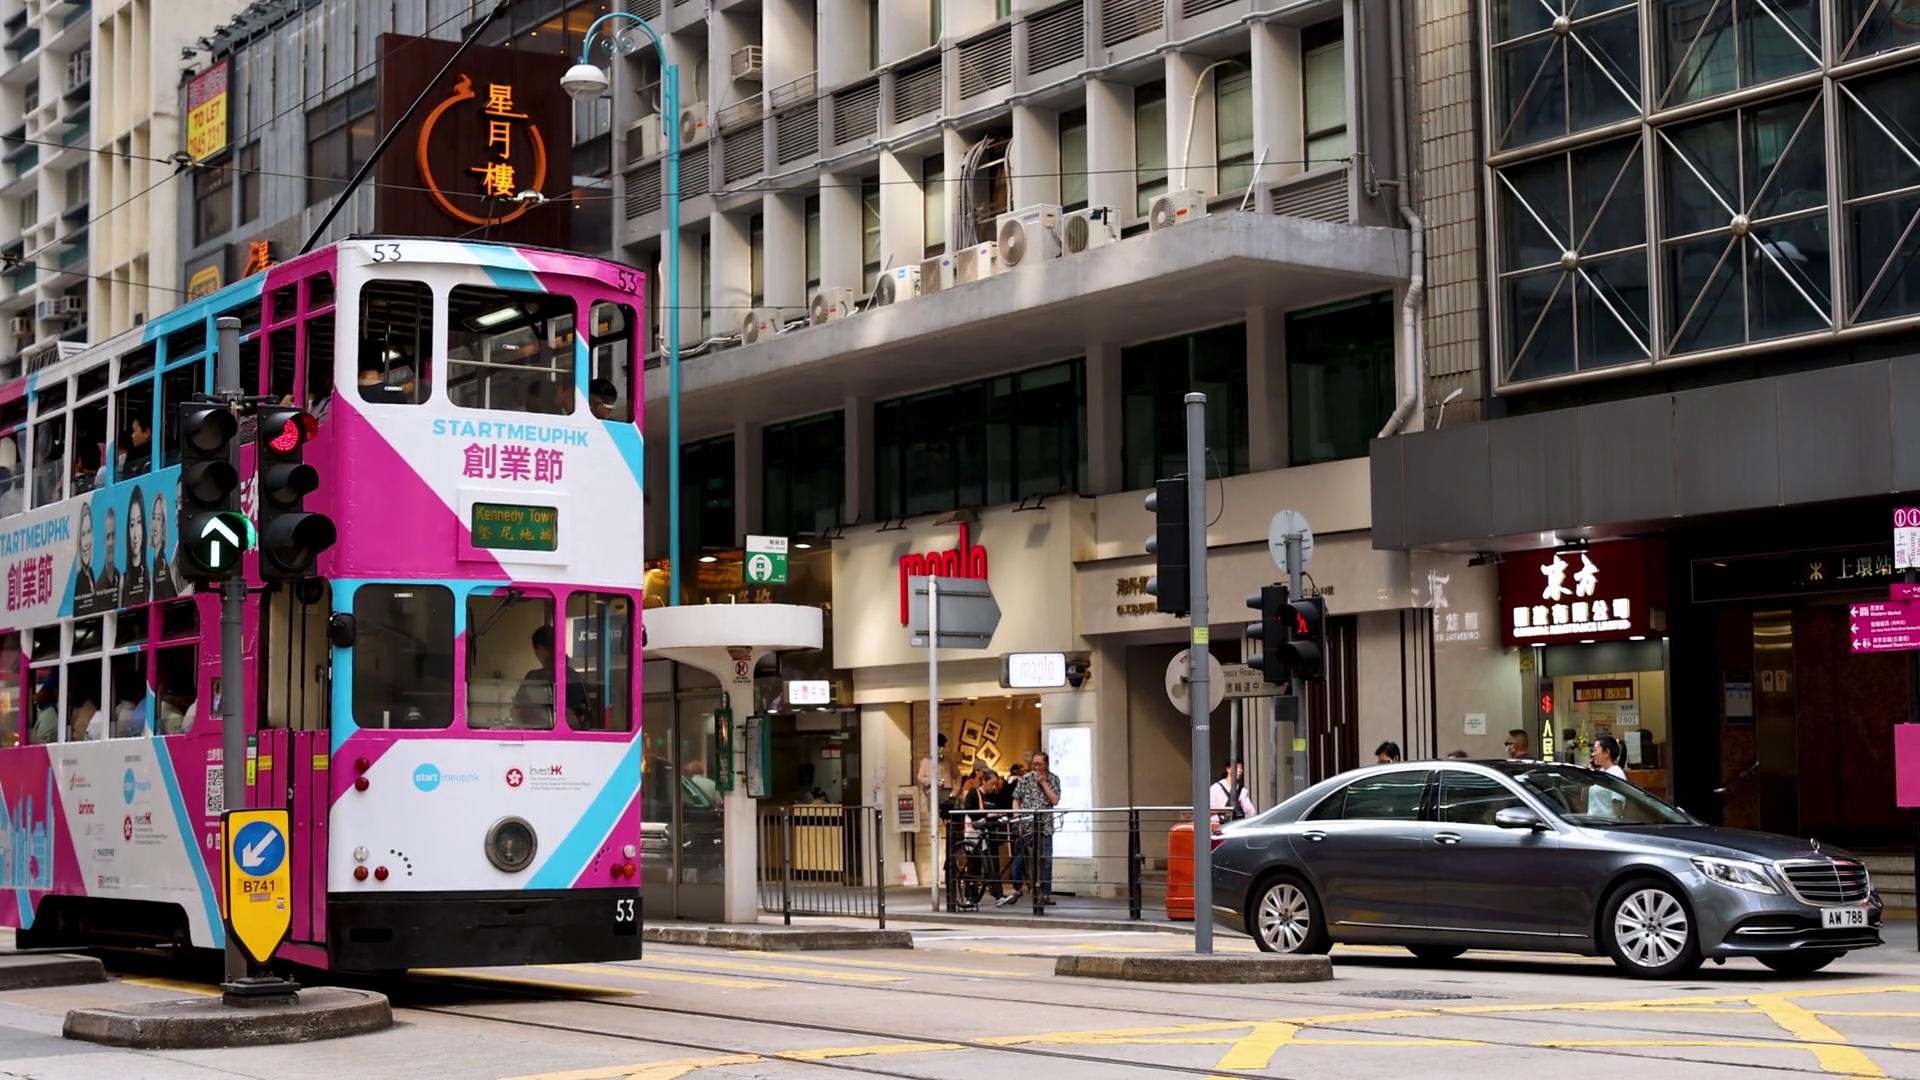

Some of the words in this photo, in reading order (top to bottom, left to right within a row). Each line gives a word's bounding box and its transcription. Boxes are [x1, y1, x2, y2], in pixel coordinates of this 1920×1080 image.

[193, 111, 204, 131] TO
[206, 99, 221, 124] LET
[471, 83, 529, 197] 星月樓
[372, 244, 402, 263] 53
[618, 269, 637, 293] 53
[432, 418, 589, 447] STARTMEUPHK
[463, 442, 564, 484] 創業節
[476, 507, 525, 524] Kennedy
[7, 553, 53, 611] 創業節
[1020, 656, 1054, 684] maple
[1239, 668, 1256, 676] Road
[529, 765, 562, 776] InvestHK
[244, 880, 275, 892] B741
[615, 899, 634, 922] 53
[1829, 911, 1842, 925] AW
[1845, 911, 1863, 924] 788
